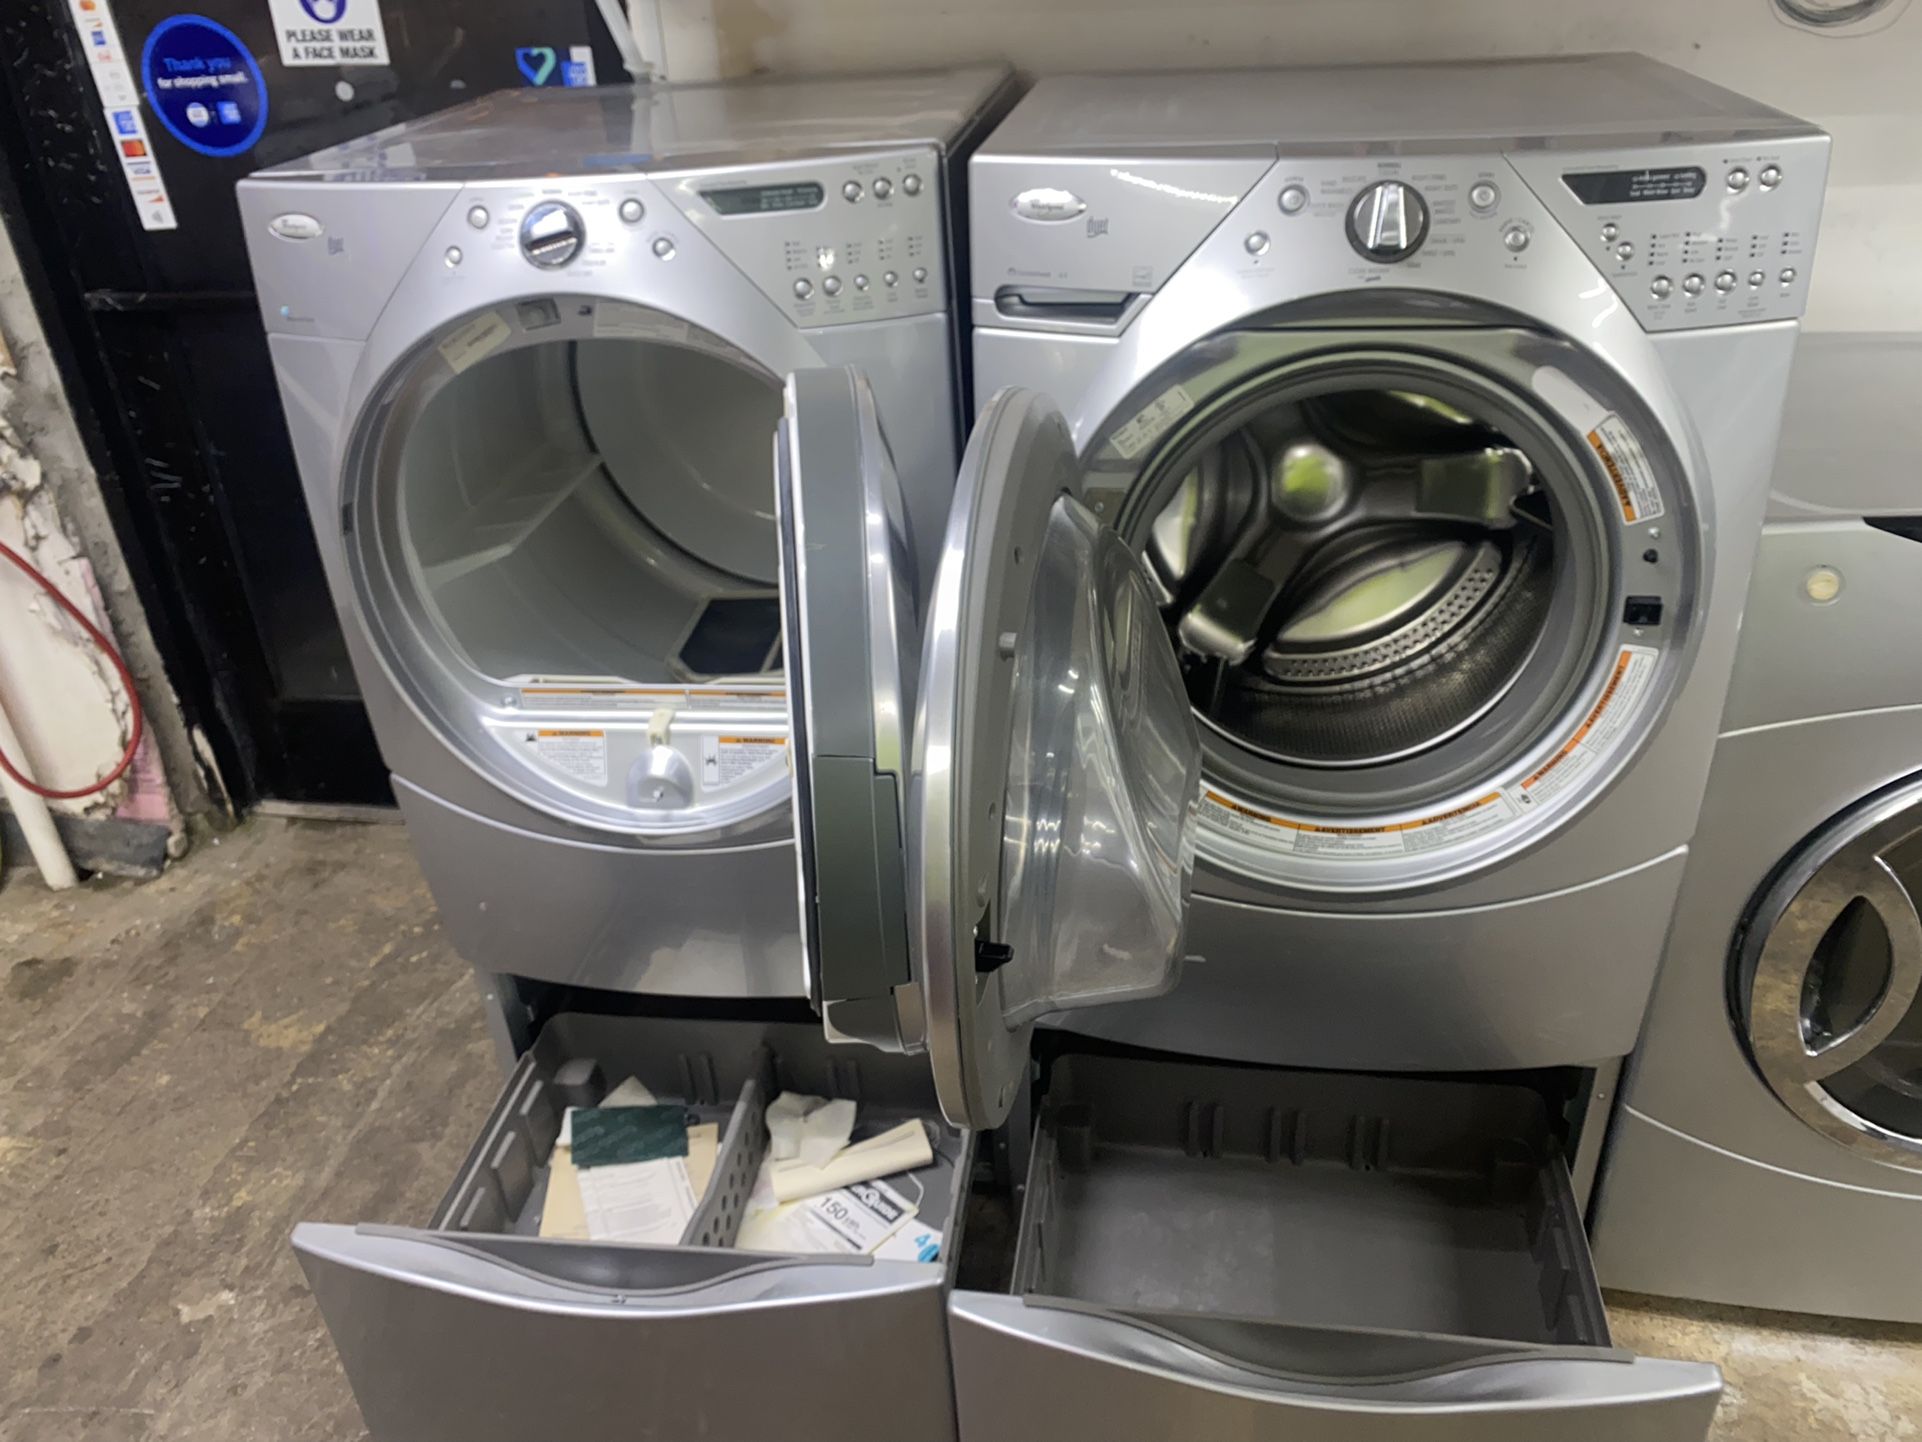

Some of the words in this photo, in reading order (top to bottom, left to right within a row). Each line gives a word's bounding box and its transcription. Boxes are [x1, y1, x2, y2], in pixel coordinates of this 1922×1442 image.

[286, 29, 334, 42] PLEASE
[339, 29, 376, 42] WEAR
[293, 46, 301, 60] A
[304, 46, 335, 59] FACE
[340, 46, 378, 59] MASK
[163, 57, 206, 72] Thank
[206, 57, 232, 73] you
[157, 76, 173, 90] for
[173, 75, 219, 90] shopping
[1236, 805, 1272, 823] WARNING
[819, 1195, 850, 1221] 150
